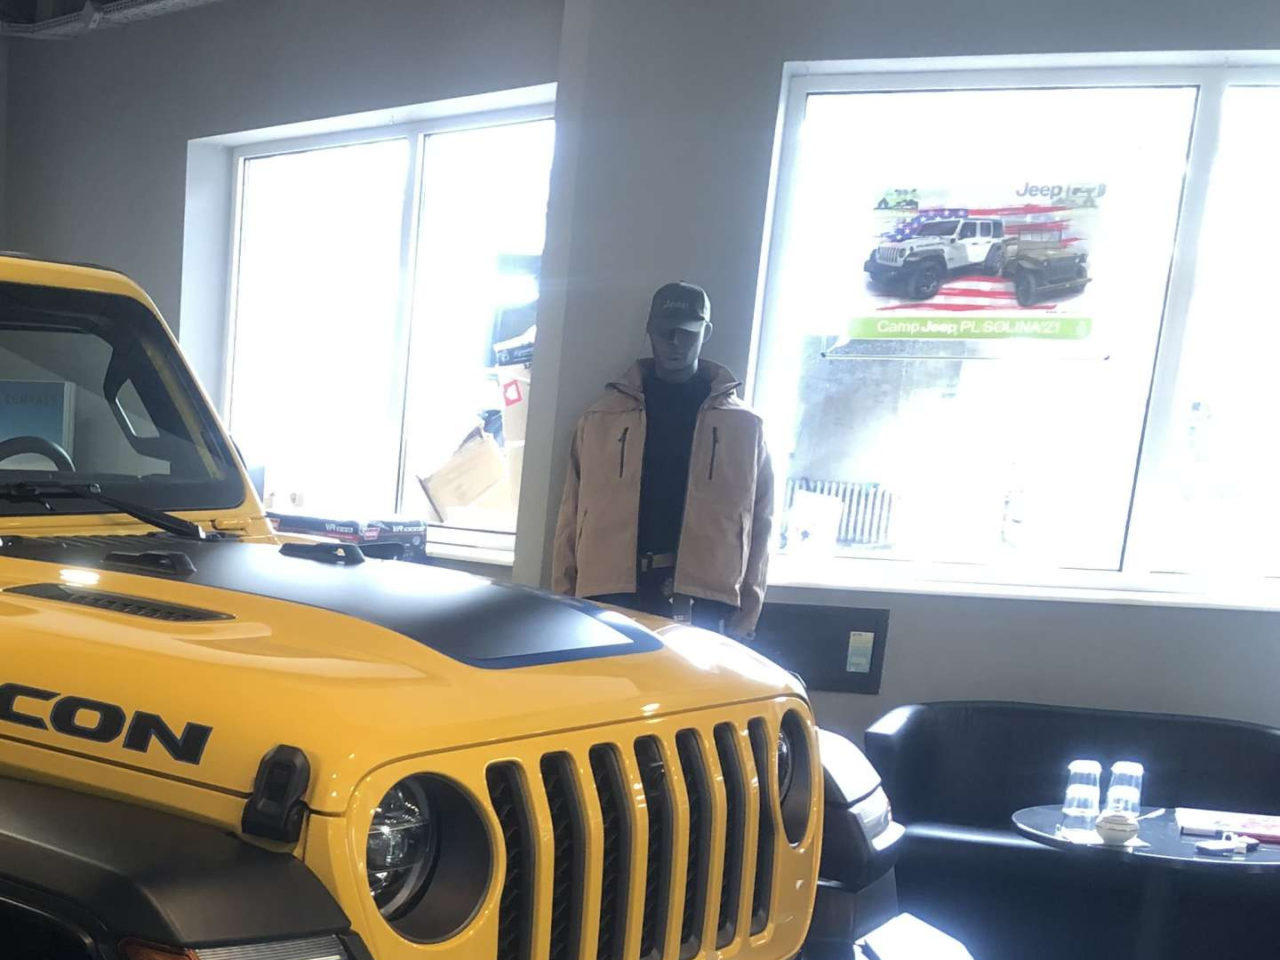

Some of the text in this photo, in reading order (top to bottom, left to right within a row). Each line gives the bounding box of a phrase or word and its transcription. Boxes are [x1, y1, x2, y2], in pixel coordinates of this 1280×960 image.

[1016, 182, 1063, 199] Jeep
[876, 320, 920, 335] Camp
[921, 321, 958, 335] Jeep
[960, 320, 980, 333] PL
